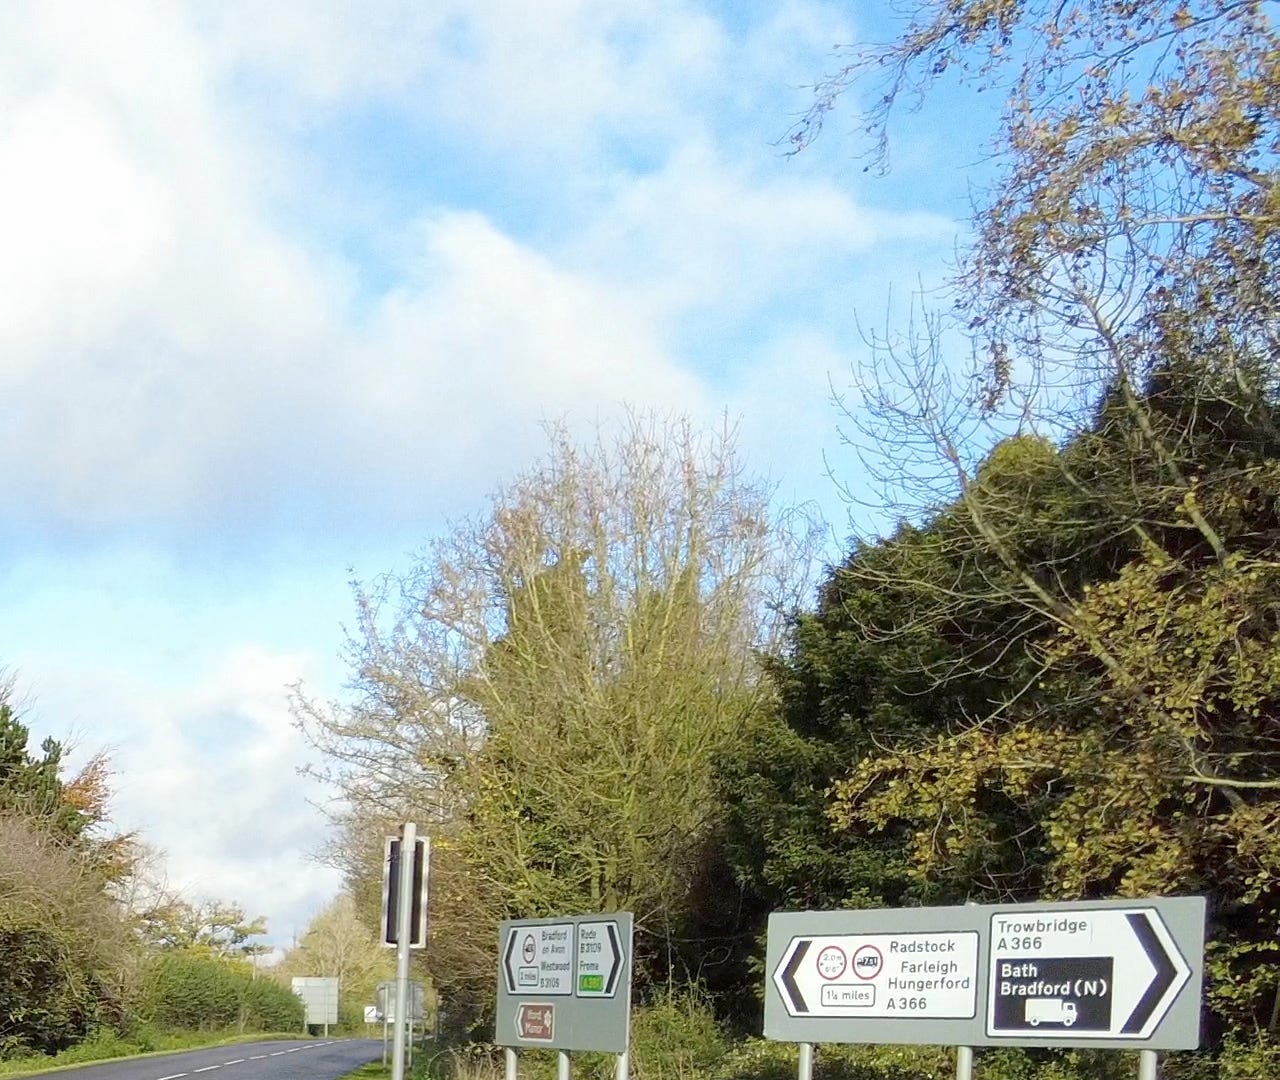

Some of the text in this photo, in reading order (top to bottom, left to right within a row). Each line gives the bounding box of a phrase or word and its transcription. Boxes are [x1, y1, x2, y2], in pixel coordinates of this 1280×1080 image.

[998, 919, 1088, 934] Trowbridge
[890, 940, 956, 953] Radstock
[900, 960, 958, 974] Farleigh
[1001, 963, 1038, 978] Bath
[888, 977, 970, 992] Hungerford
[1000, 979, 1108, 997] Bradford (N)
[842, 990, 870, 1000] miles
